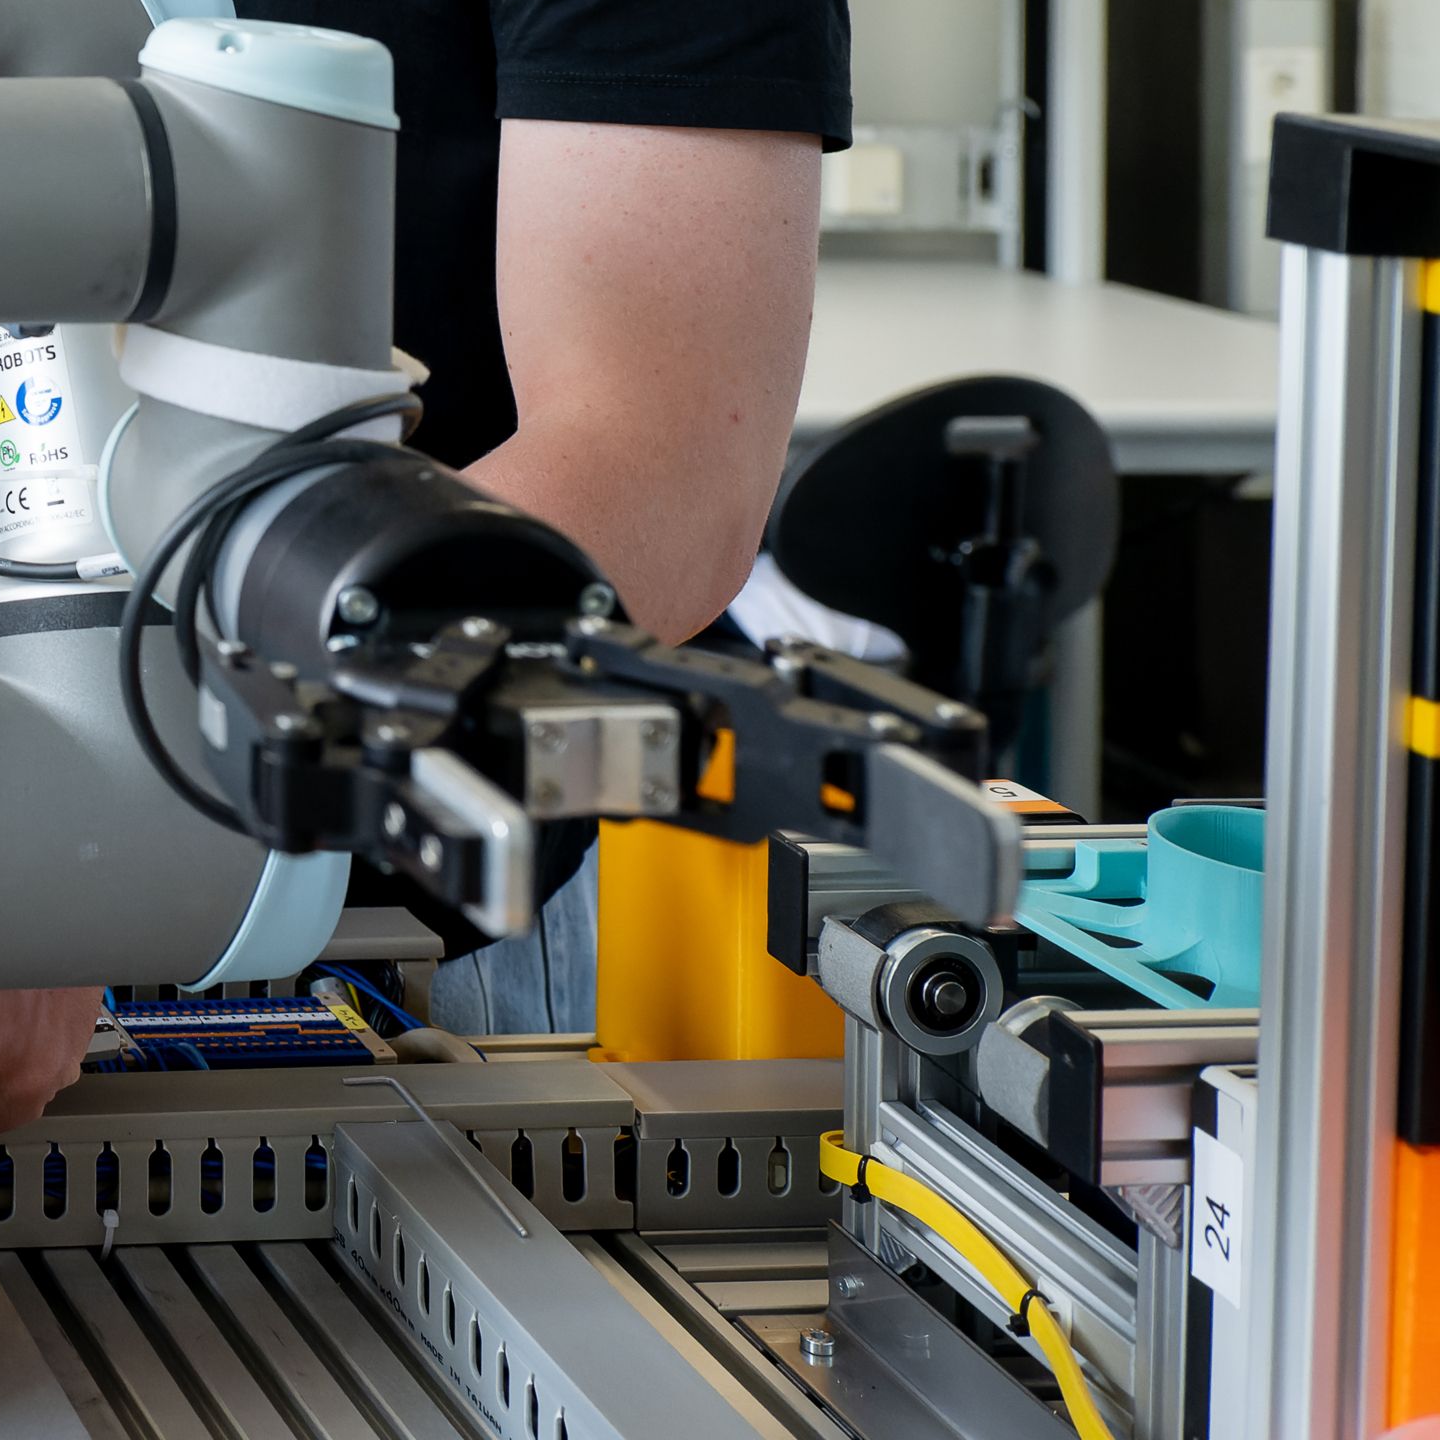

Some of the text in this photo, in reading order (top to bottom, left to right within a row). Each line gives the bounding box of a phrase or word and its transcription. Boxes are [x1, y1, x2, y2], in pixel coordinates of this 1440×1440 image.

[5, 486, 30, 515] CE
[1204, 1195, 1230, 1263] 24
[420, 1332, 445, 1365] MADE
[465, 1385, 503, 1435] TAIWAN
